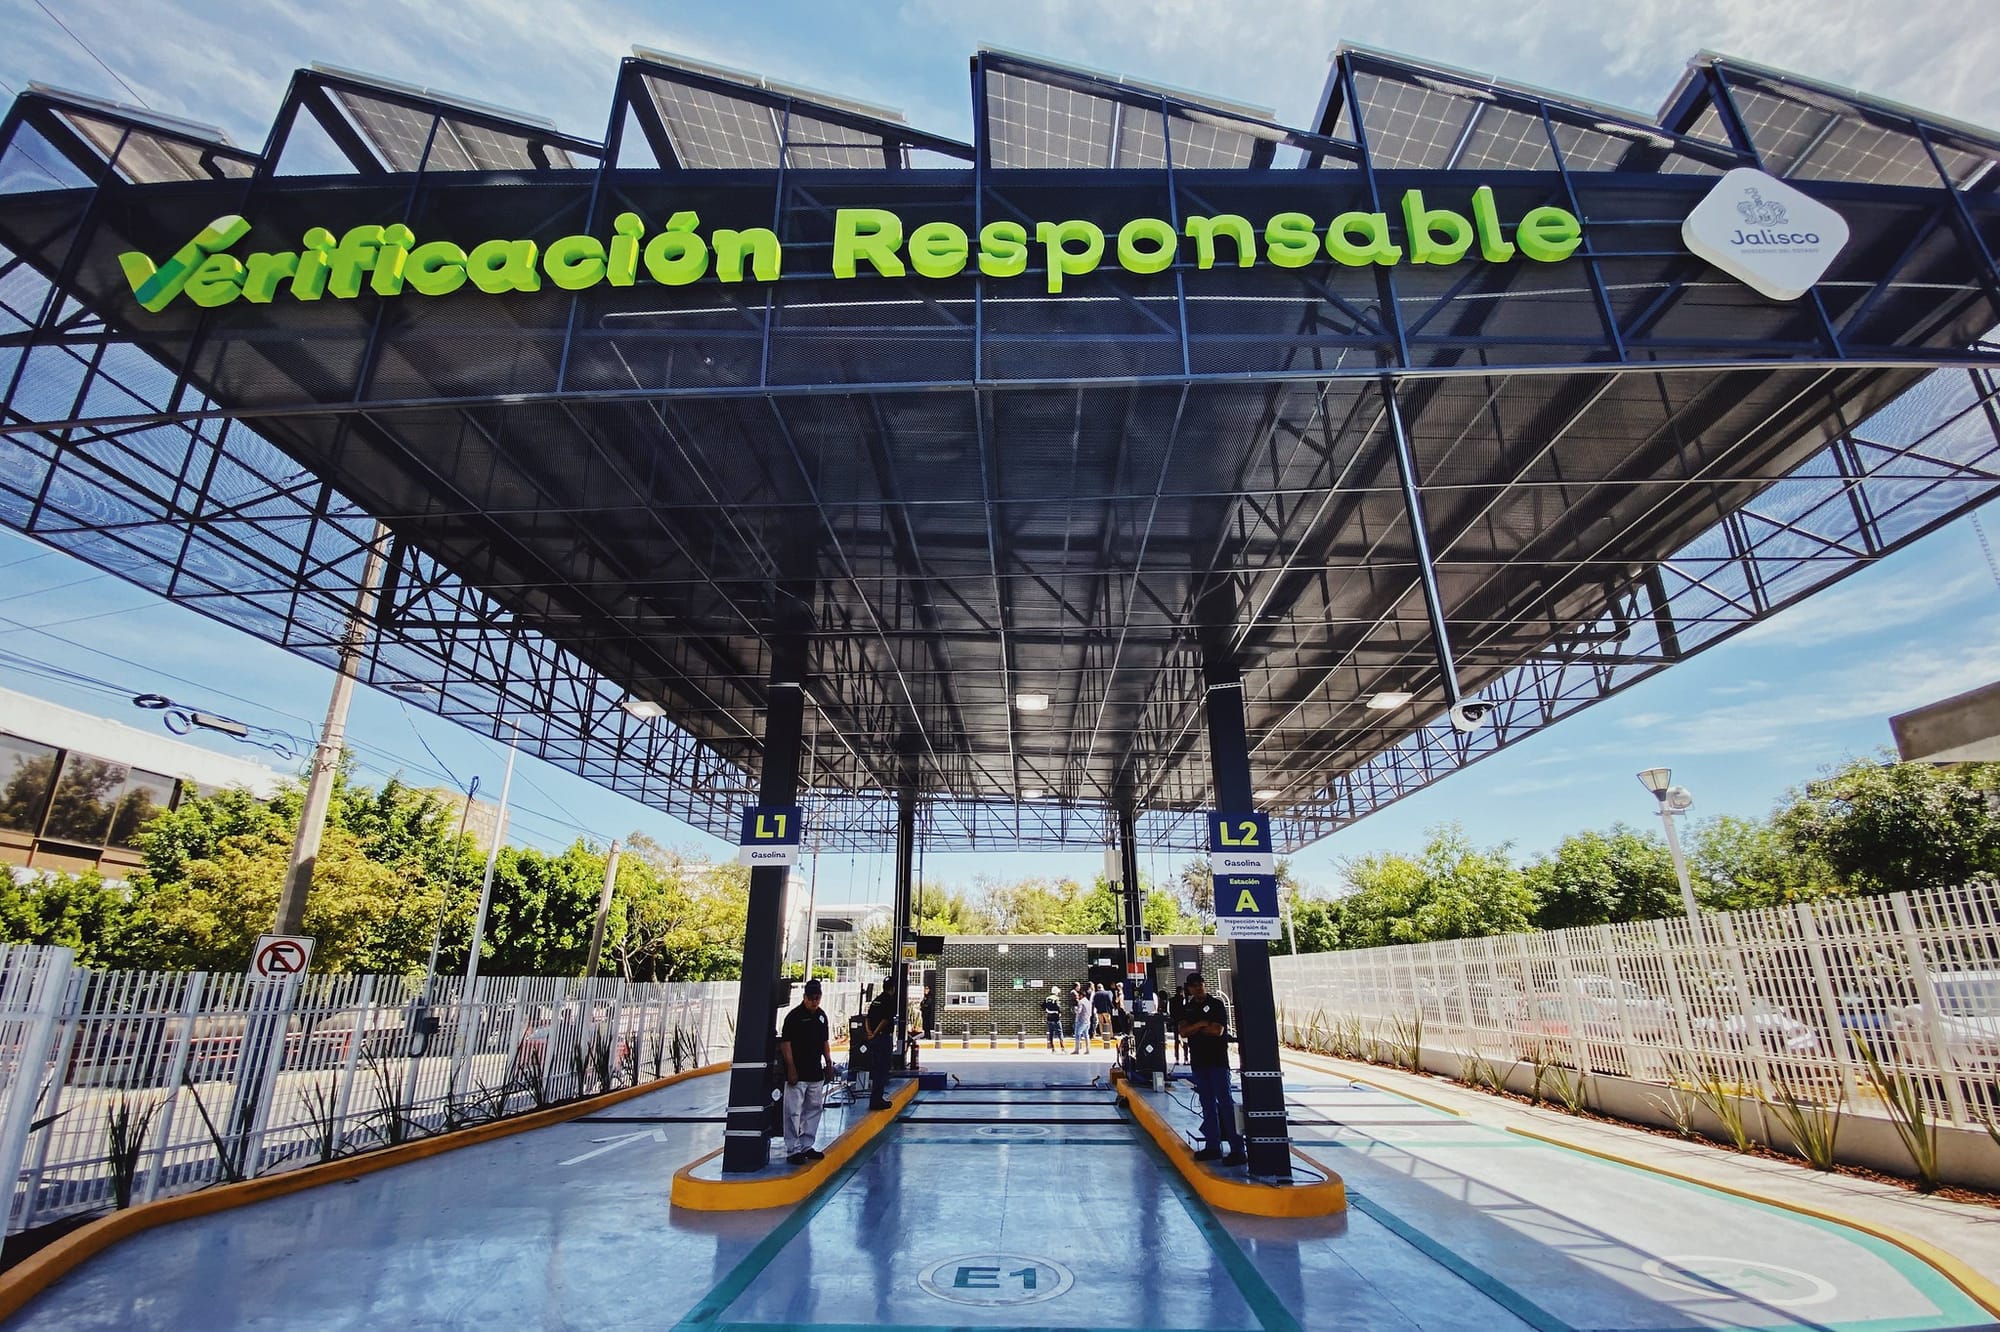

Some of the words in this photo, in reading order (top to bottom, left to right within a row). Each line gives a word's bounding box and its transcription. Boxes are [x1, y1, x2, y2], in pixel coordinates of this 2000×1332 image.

[1730, 229, 1820, 245] Jalisco
[118, 211, 782, 313] Verificación
[832, 186, 1583, 294] Responsable
[755, 814, 787, 838] L1
[1219, 821, 1259, 846] L2
[751, 851, 786, 859] Gasolina
[1224, 859, 1261, 867] Gasolina
[1229, 877, 1260, 885] Estación
[1235, 889, 1260, 913] A
[952, 1267, 1036, 1289] E1
